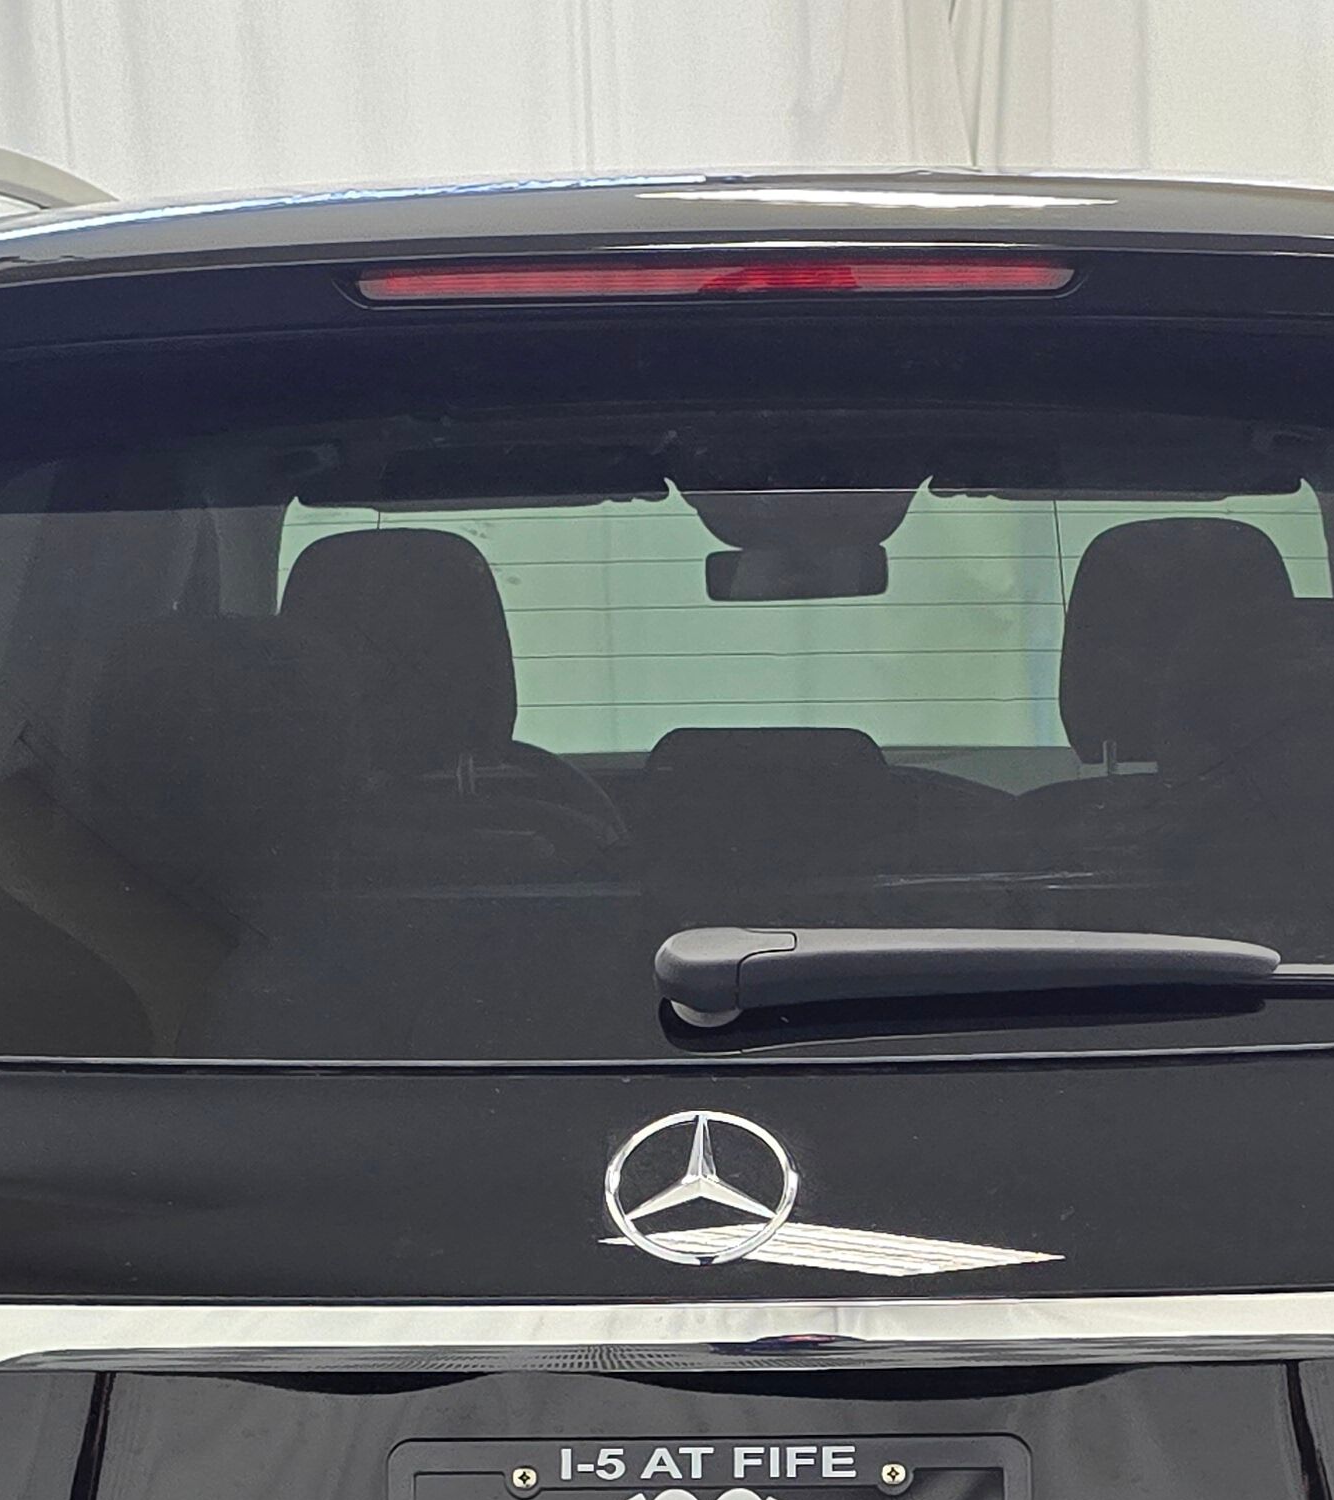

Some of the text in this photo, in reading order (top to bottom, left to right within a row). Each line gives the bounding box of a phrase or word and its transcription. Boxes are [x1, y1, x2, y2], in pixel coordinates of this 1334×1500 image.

[560, 1445, 857, 1480] I-5 AT FIFE
